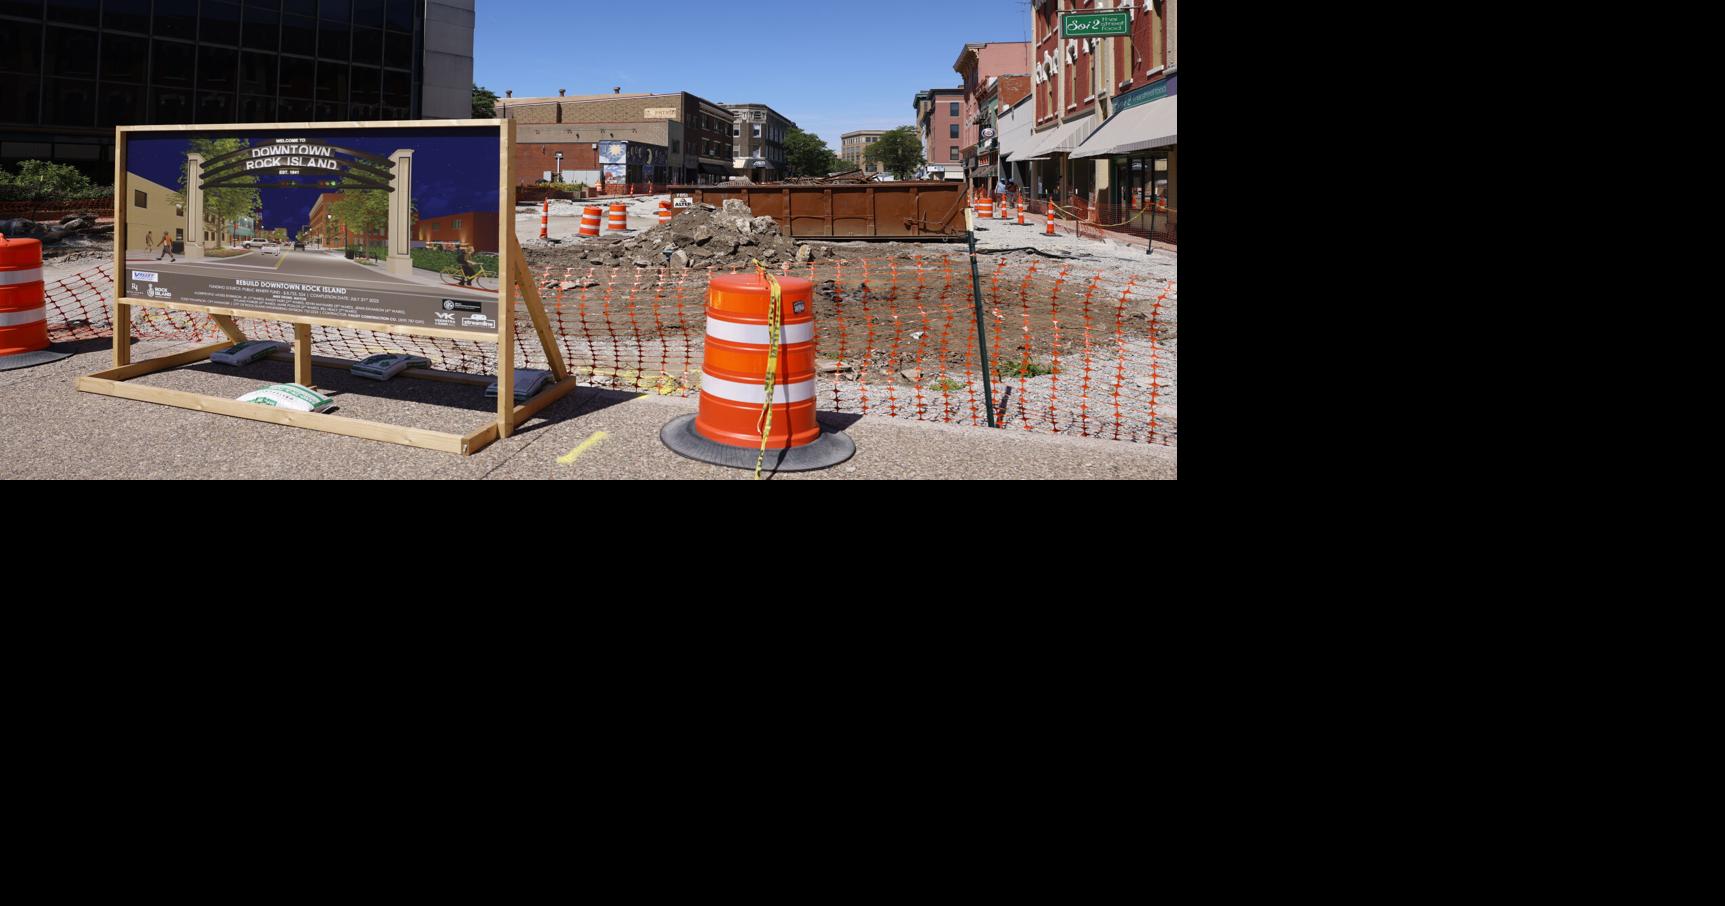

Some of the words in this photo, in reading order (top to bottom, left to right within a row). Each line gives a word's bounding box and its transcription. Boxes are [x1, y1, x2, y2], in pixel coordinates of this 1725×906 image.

[1067, 20, 1091, 31] Soi
[1092, 19, 1100, 30] 2
[252, 145, 331, 158] DOWNTOWN
[246, 157, 281, 170] ROCK
[287, 157, 338, 170] ISLAND
[235, 279, 260, 288] REBUILD
[260, 281, 300, 290] DOWNTOWN
[301, 284, 321, 292] ROCK
[322, 286, 347, 294] ISLAND
[434, 311, 456, 320] VK
